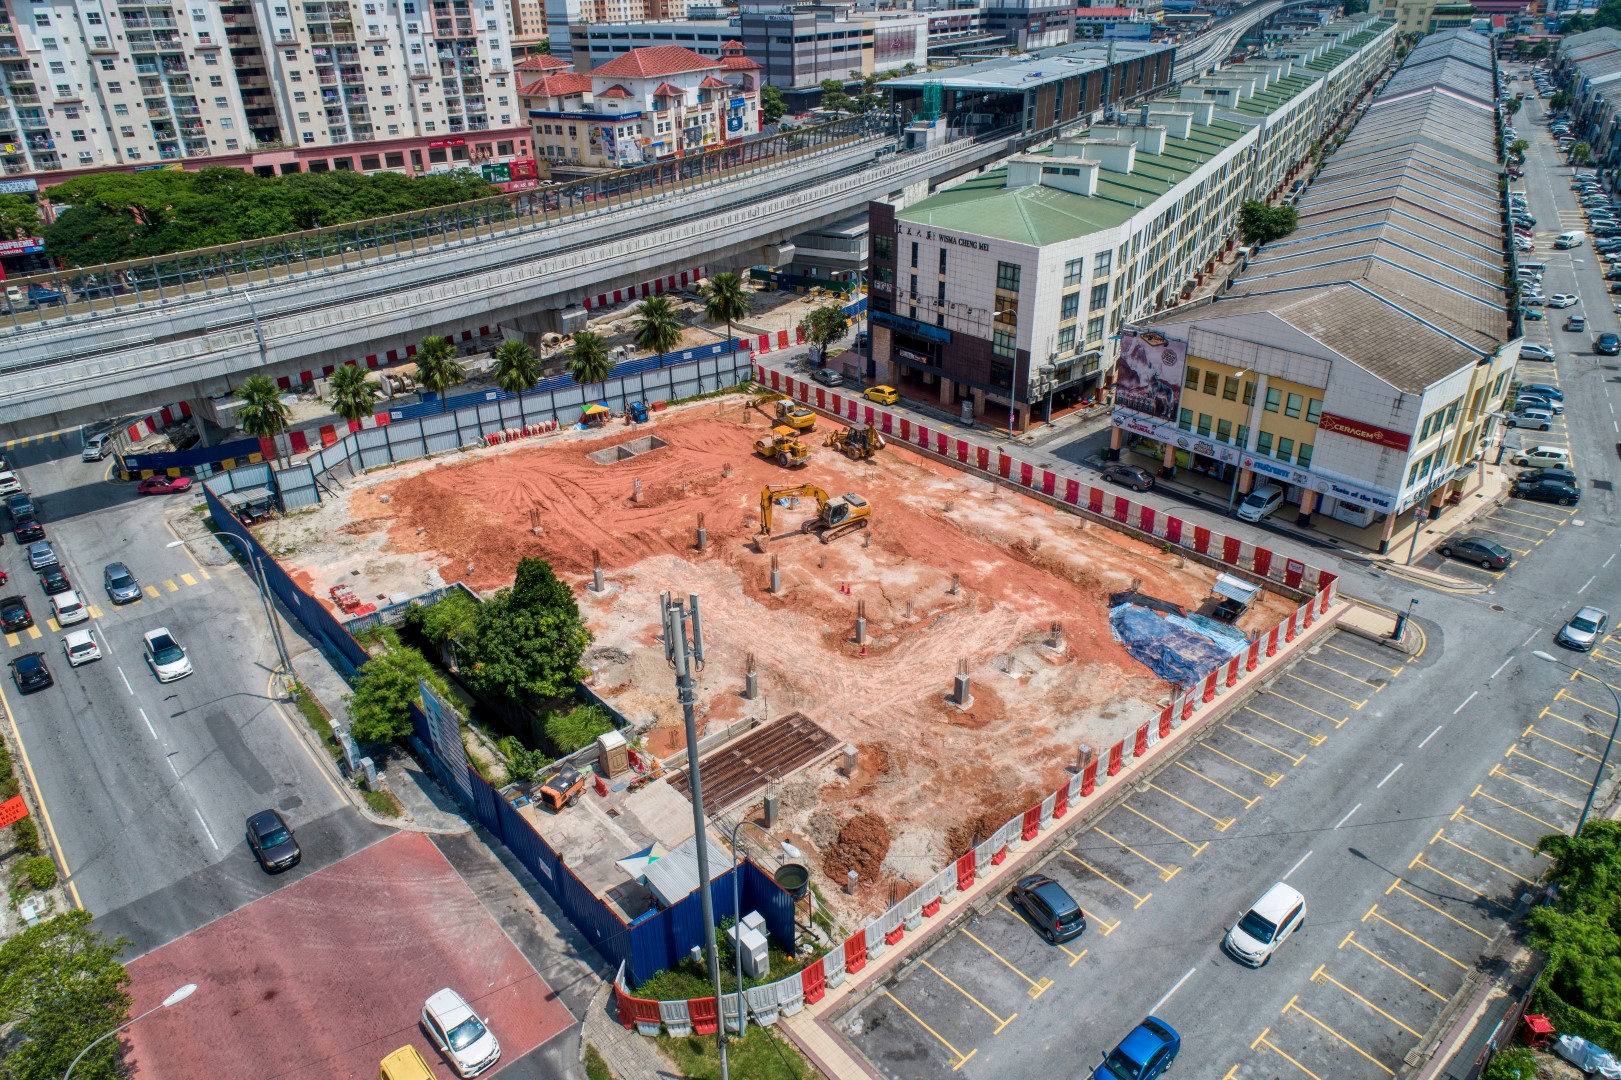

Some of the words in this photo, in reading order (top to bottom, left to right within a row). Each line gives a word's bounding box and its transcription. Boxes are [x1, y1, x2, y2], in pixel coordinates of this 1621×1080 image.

[939, 233, 957, 245] WISMA
[958, 238, 977, 250] CHENG
[978, 242, 989, 251] MEI
[1334, 423, 1374, 440] CERAGEM
[1331, 484, 1350, 495] Taste
[1359, 493, 1371, 502] the
[1372, 497, 1390, 508] Wild
